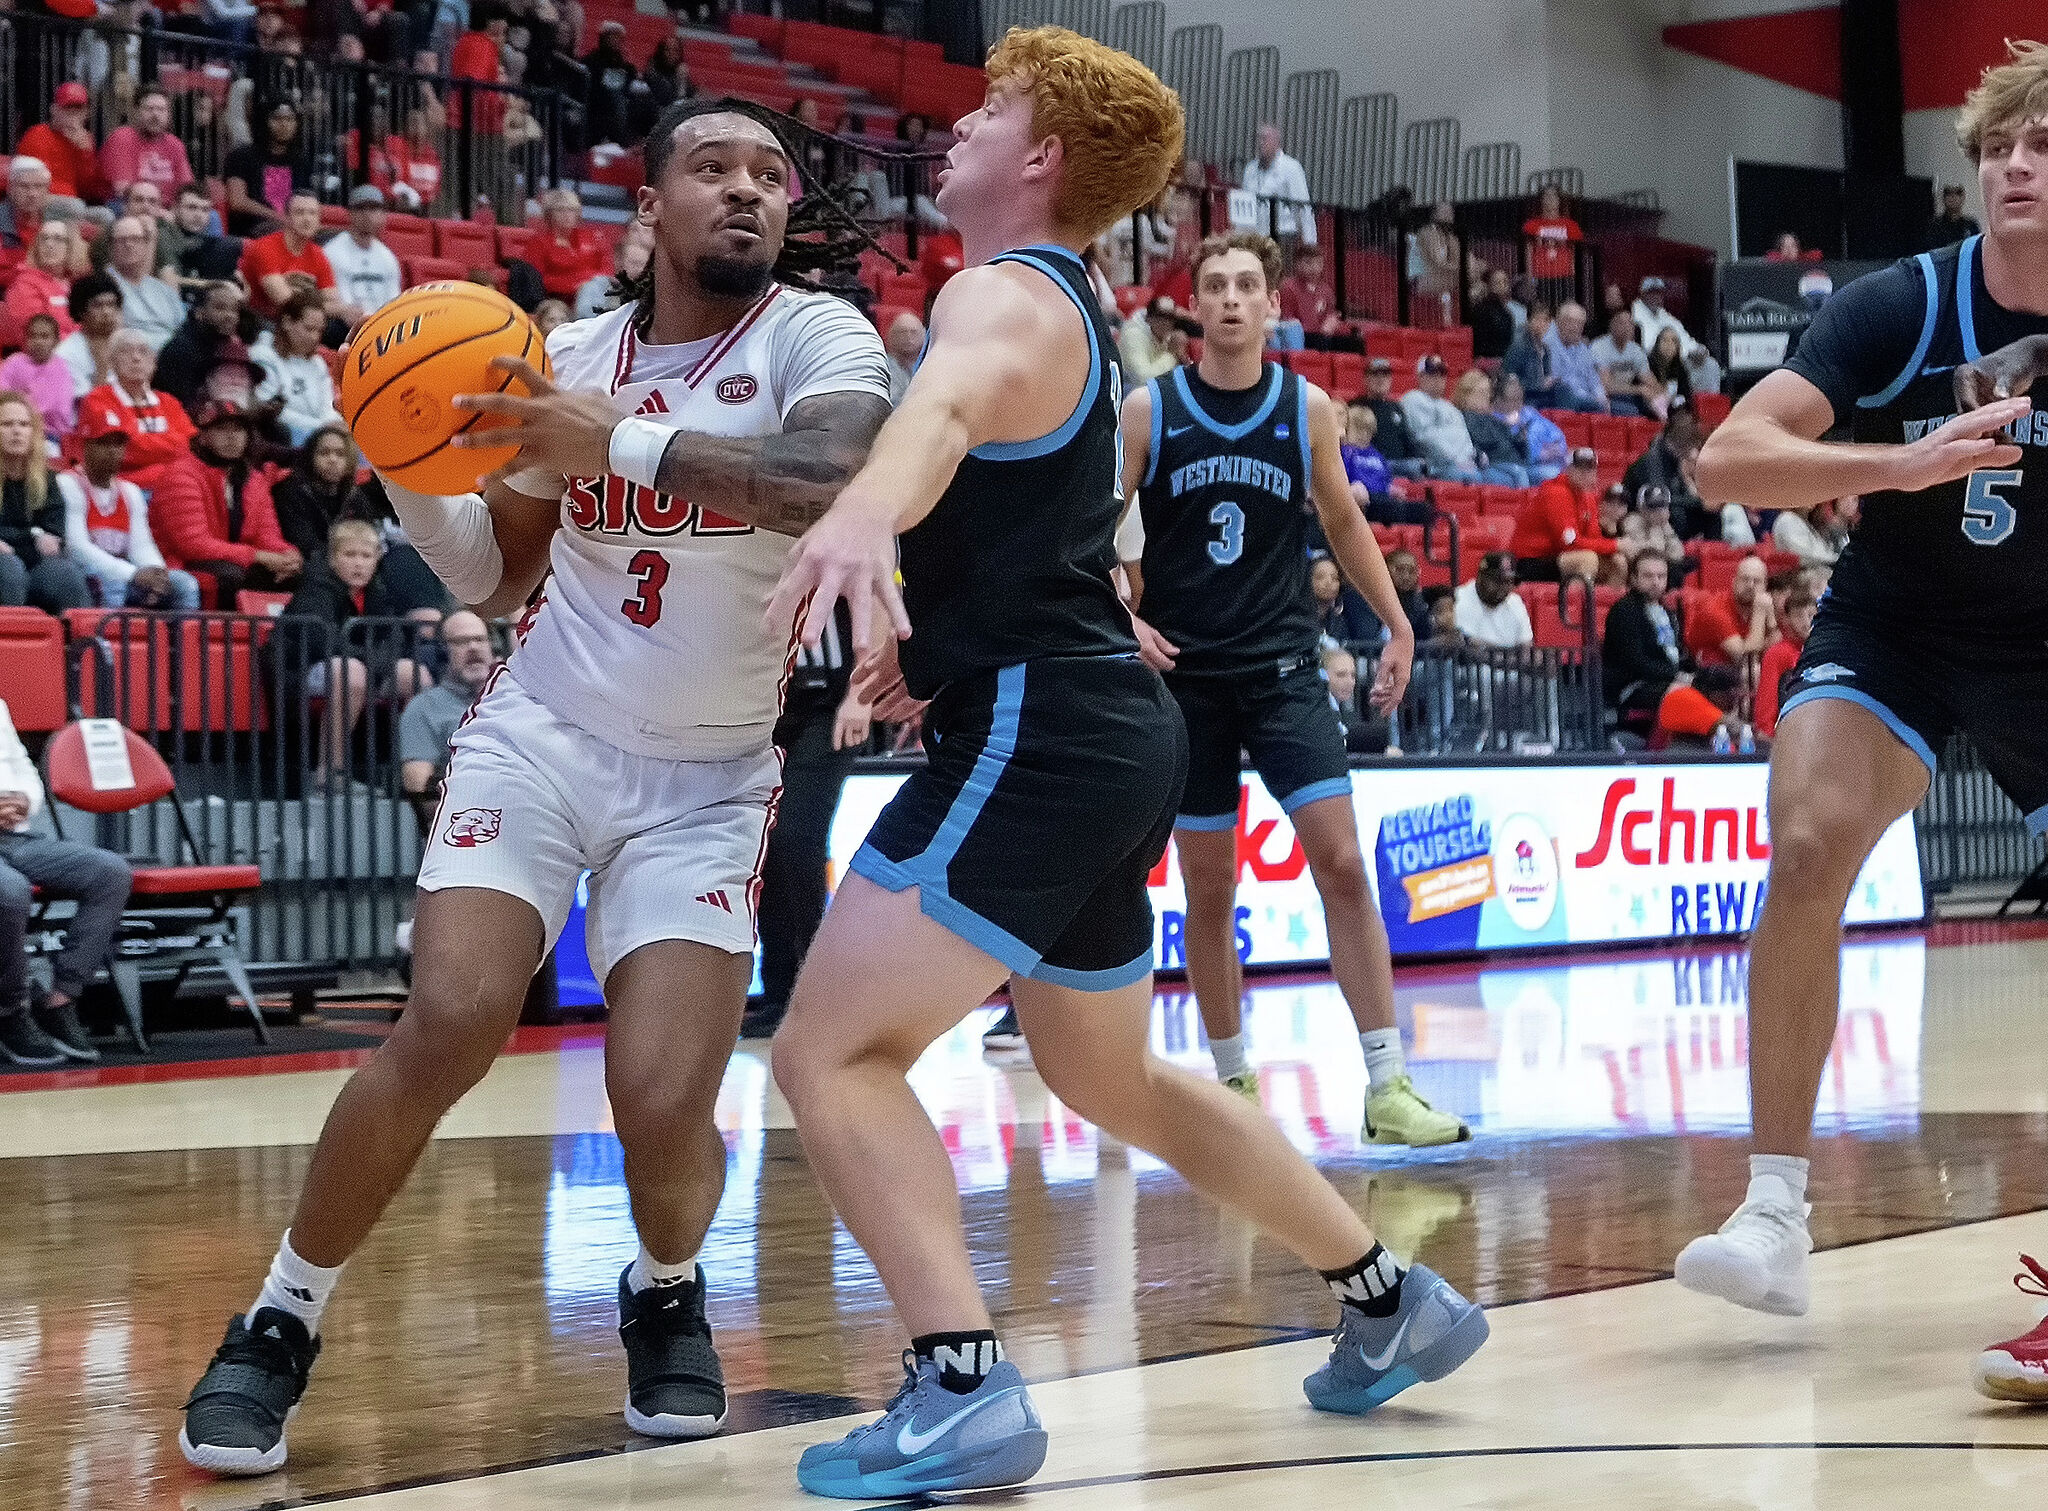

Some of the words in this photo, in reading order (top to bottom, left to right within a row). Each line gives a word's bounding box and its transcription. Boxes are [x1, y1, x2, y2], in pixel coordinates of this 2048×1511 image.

[722, 382, 751, 398] OVC
[1169, 454, 1293, 502] WESTMINSTER
[1961, 468, 2024, 546] 5
[1207, 501, 1246, 566] 3
[620, 549, 671, 630] 3
[1382, 793, 1474, 844] REWARD
[1385, 819, 1493, 877] YOURSELF
